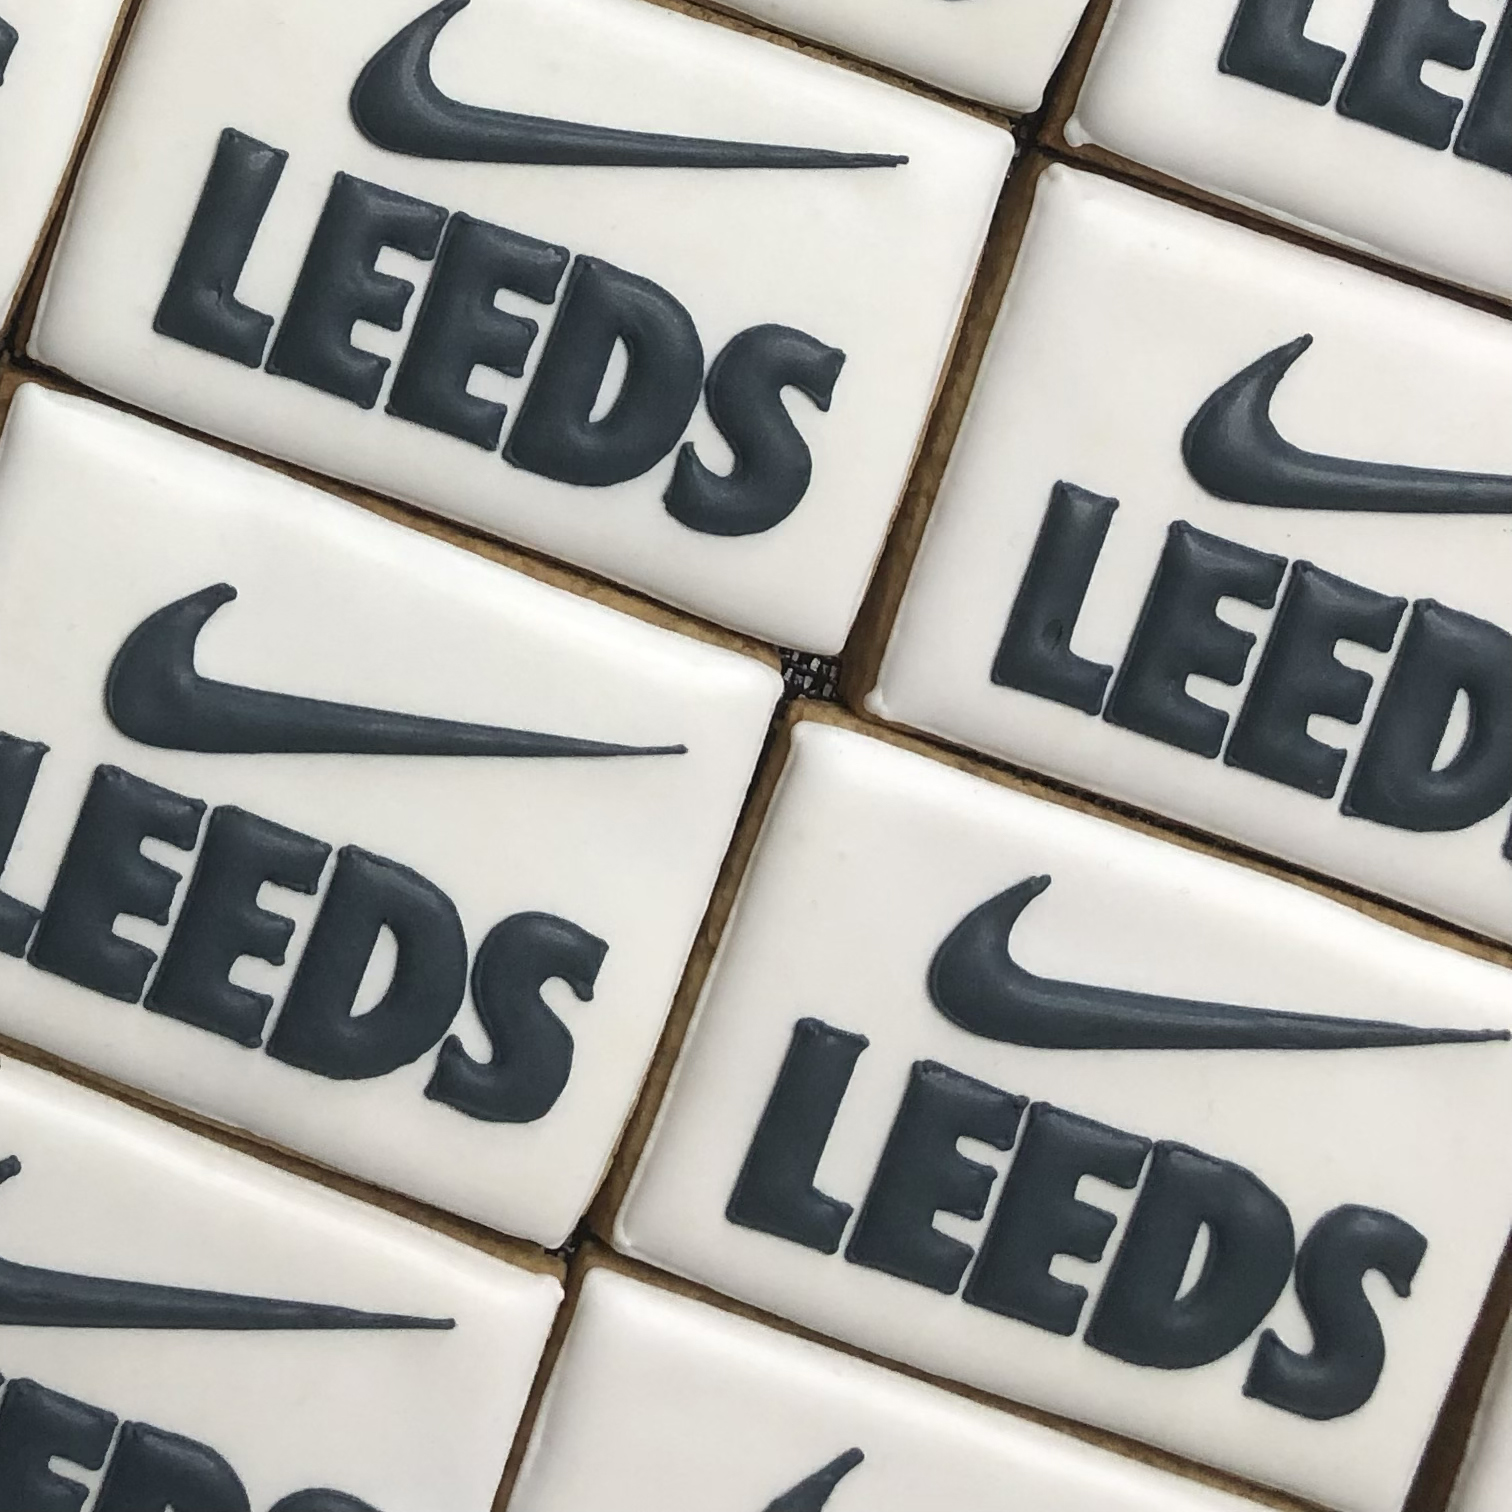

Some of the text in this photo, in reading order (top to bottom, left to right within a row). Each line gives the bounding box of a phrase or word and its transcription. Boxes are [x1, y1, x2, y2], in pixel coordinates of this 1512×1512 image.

[151, 125, 847, 539] LEEDS
[988, 480, 1512, 860] LEED
[723, 1016, 1429, 1423] LEEDS
